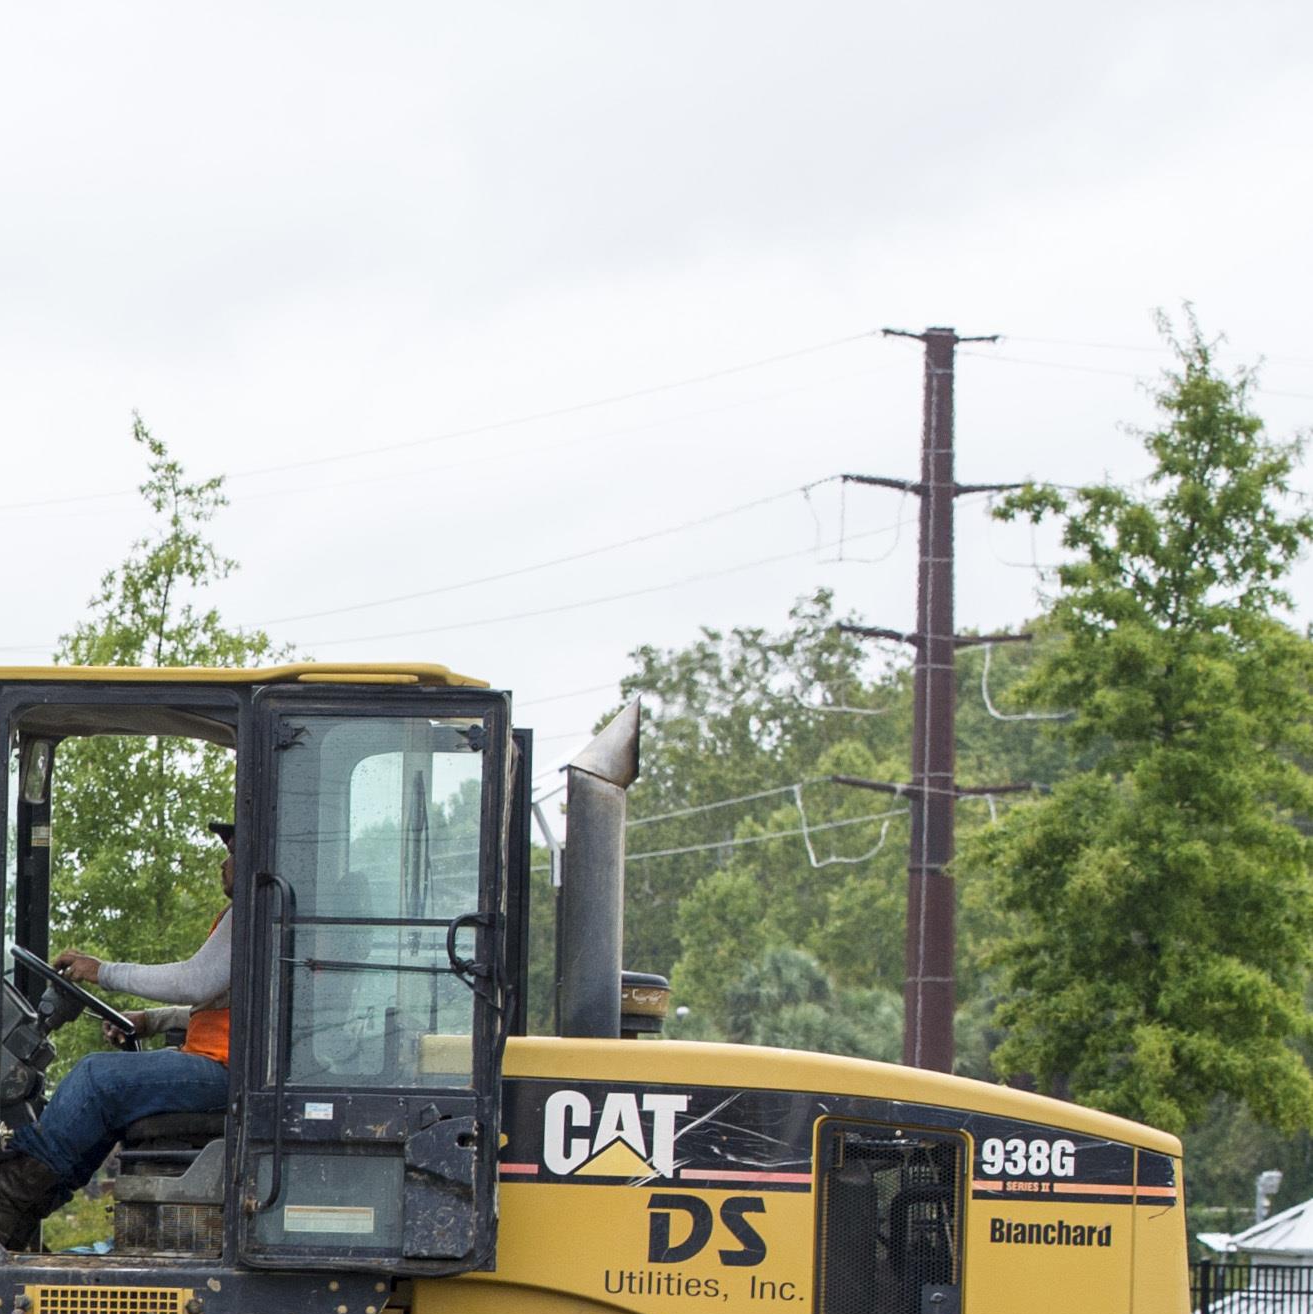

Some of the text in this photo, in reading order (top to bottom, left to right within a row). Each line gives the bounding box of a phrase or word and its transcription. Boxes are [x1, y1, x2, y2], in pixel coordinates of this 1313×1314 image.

[543, 1089, 688, 1179] CAT
[981, 1138, 1076, 1177] 938G
[1006, 1181, 1039, 1193] SERIES
[646, 1193, 768, 1268] DS
[603, 1270, 805, 1301] Utilities, Inc.
